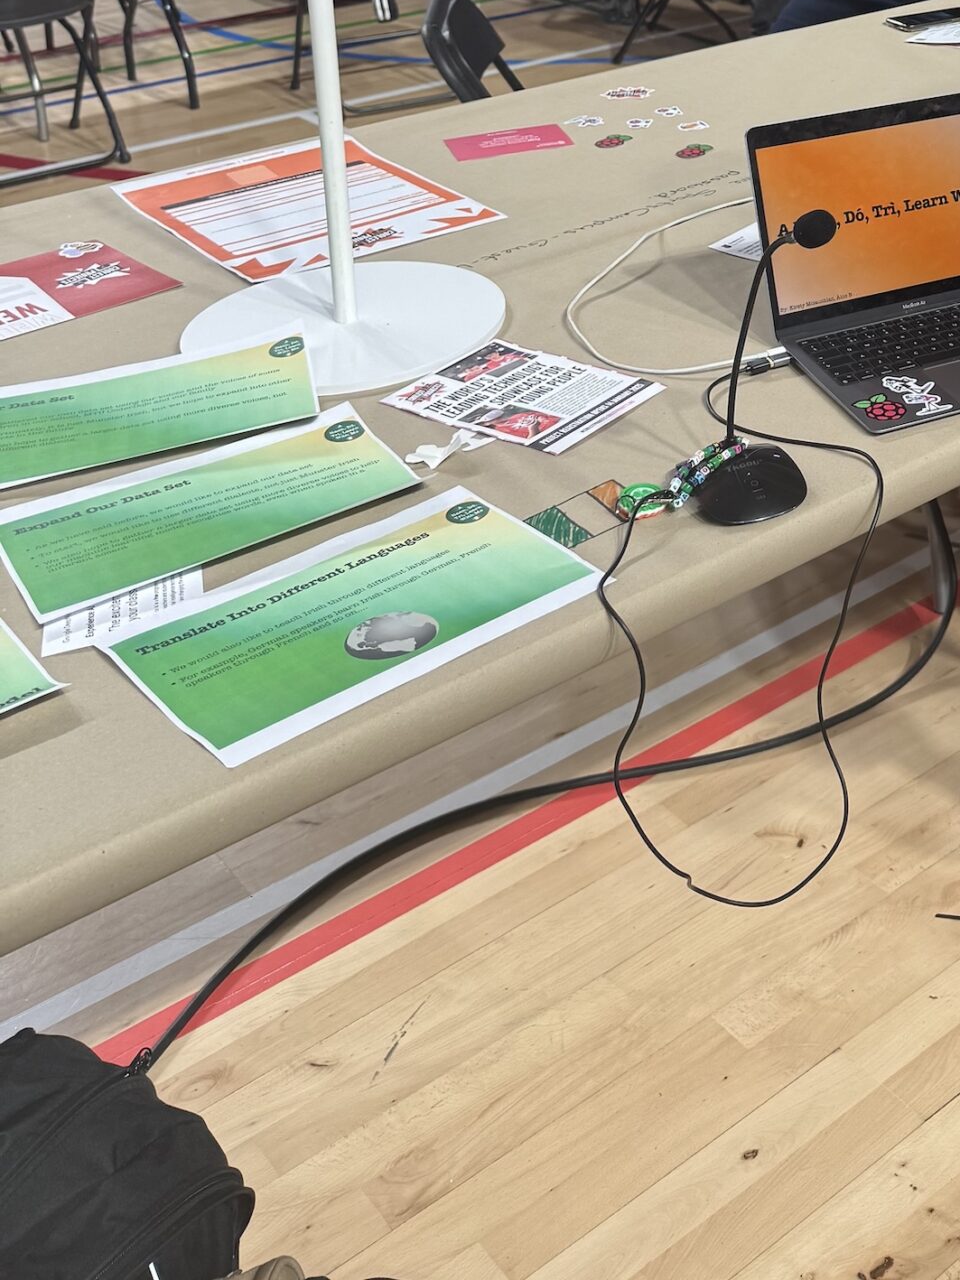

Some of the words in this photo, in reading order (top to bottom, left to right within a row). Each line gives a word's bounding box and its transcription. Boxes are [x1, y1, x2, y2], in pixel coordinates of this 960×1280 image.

[777, 223, 789, 236] A
[844, 207, 869, 224] Dó,
[903, 194, 948, 213] Learn
[902, 302, 919, 310] MacBook
[8, 398, 45, 409] Data
[48, 394, 75, 403] Set
[422, 399, 452, 413] THE
[442, 376, 495, 402] WORLD'S
[439, 392, 491, 418] LEADING
[483, 360, 548, 394] TECHNOLOGY
[488, 375, 546, 405] SHOWCASE
[538, 365, 565, 377] FOR
[513, 384, 554, 405] YOUNG
[545, 365, 587, 386] PEOPLE
[12, 511, 82, 535] Expand
[84, 500, 119, 514] Our
[119, 488, 160, 504] Data
[162, 478, 192, 491] Set
[135, 617, 227, 656] Translate
[225, 601, 267, 621] Into
[279, 566, 346, 597] Different
[343, 532, 431, 569] Languages
[187, 650, 220, 666] would
[219, 640, 242, 652] also
[242, 631, 262, 643] like
[274, 613, 303, 629] teach
[302, 603, 327, 616] Irish
[326, 586, 367, 606] through
[365, 568, 406, 589] different
[405, 548, 452, 571] languages
[200, 651, 248, 675] example,
[247, 633, 289, 653] German
[289, 613, 334, 636] speakers
[332, 601, 361, 616] learn
[359, 591, 384, 604] Irish
[383, 574, 422, 594] through
[420, 556, 461, 576] German,
[459, 542, 492, 558] French
[129, 608, 141, 623] your
[184, 664, 233, 689] speakers
[232, 646, 275, 667] through
[275, 629, 313, 648] French
